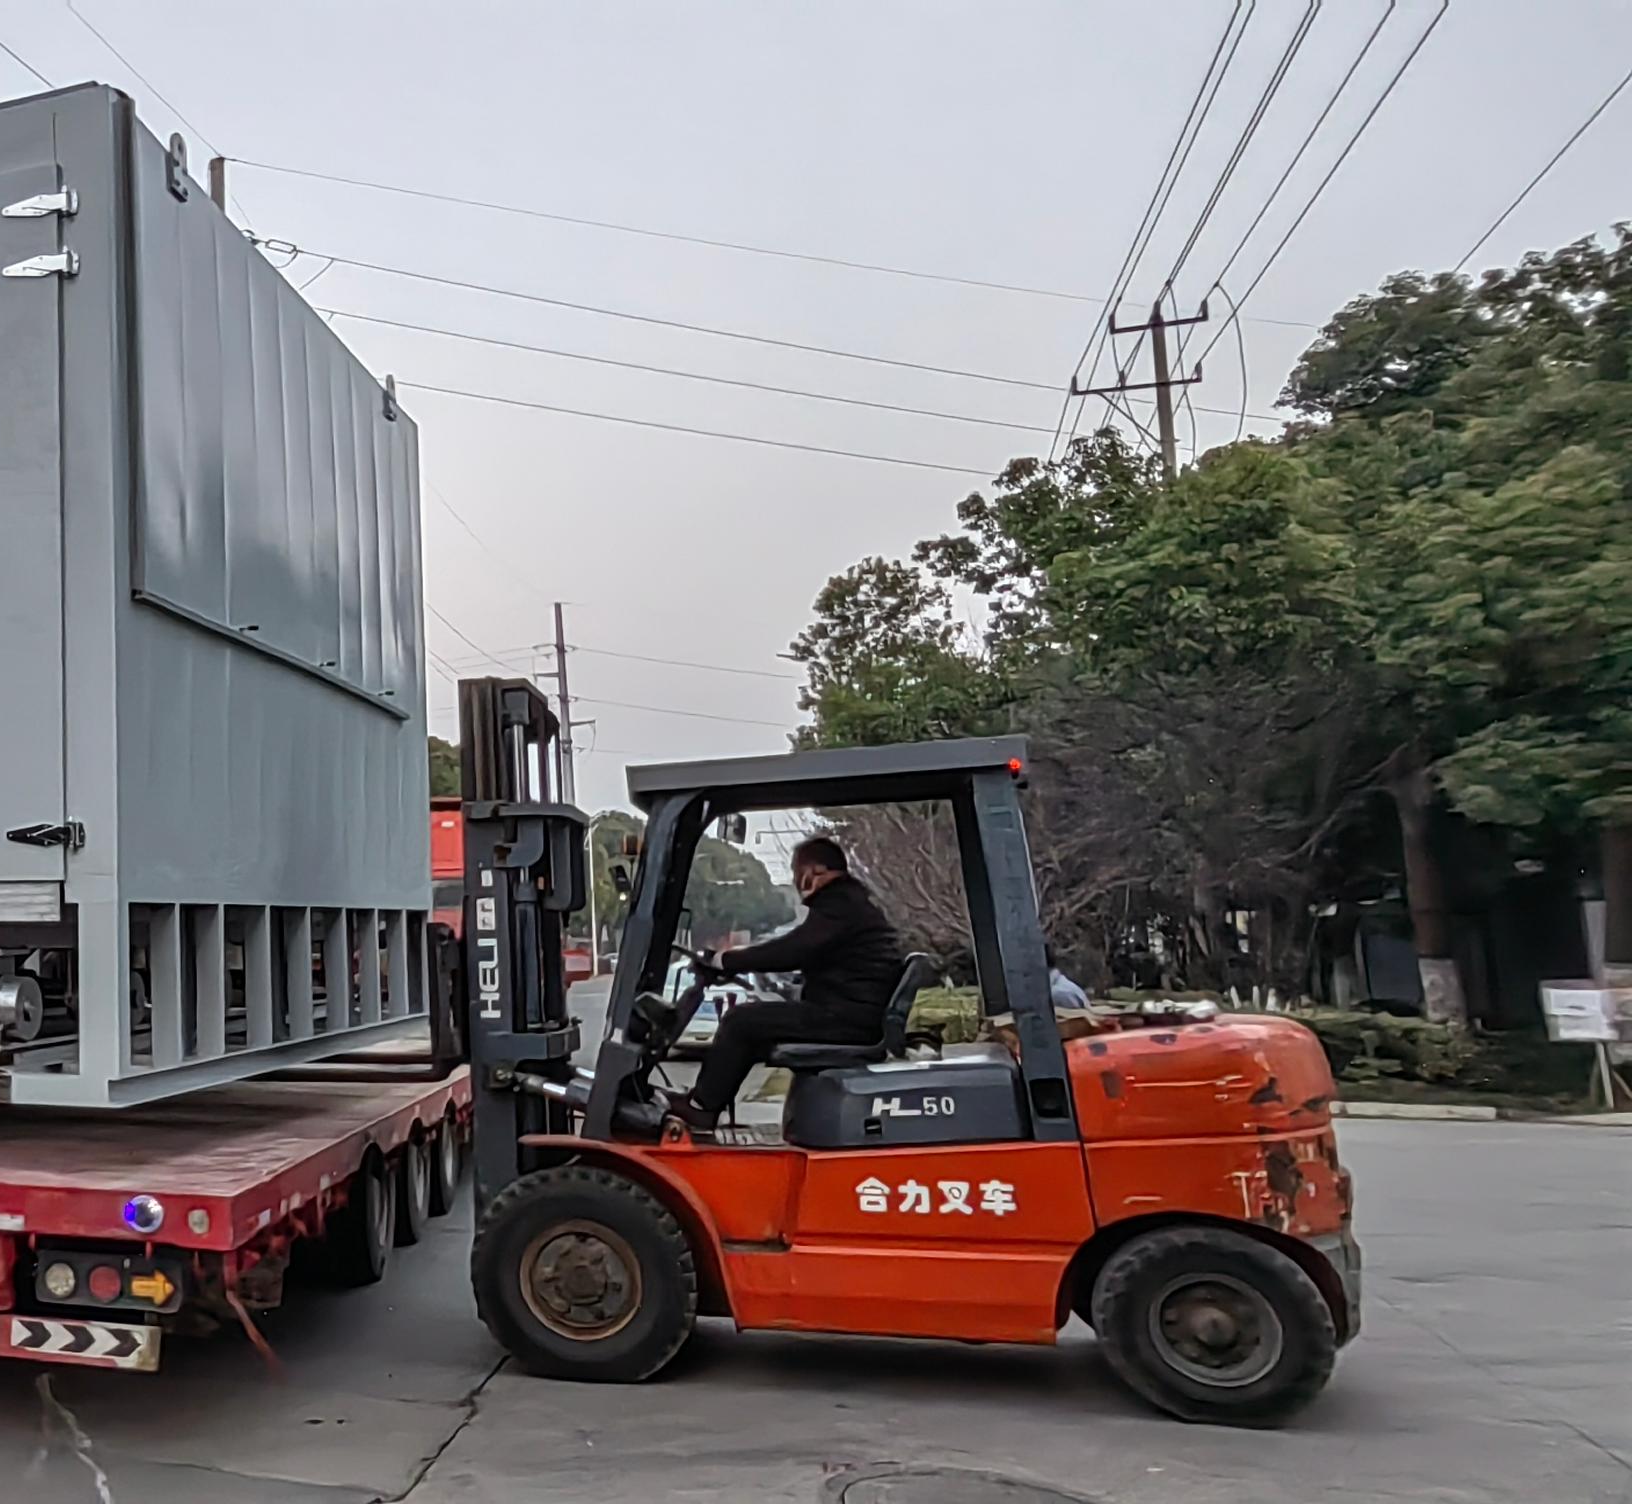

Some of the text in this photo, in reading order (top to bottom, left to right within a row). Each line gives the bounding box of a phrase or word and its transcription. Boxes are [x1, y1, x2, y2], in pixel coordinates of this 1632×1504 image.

[477, 938, 501, 1018] HELI
[855, 1177, 1017, 1215] 合力叉车
